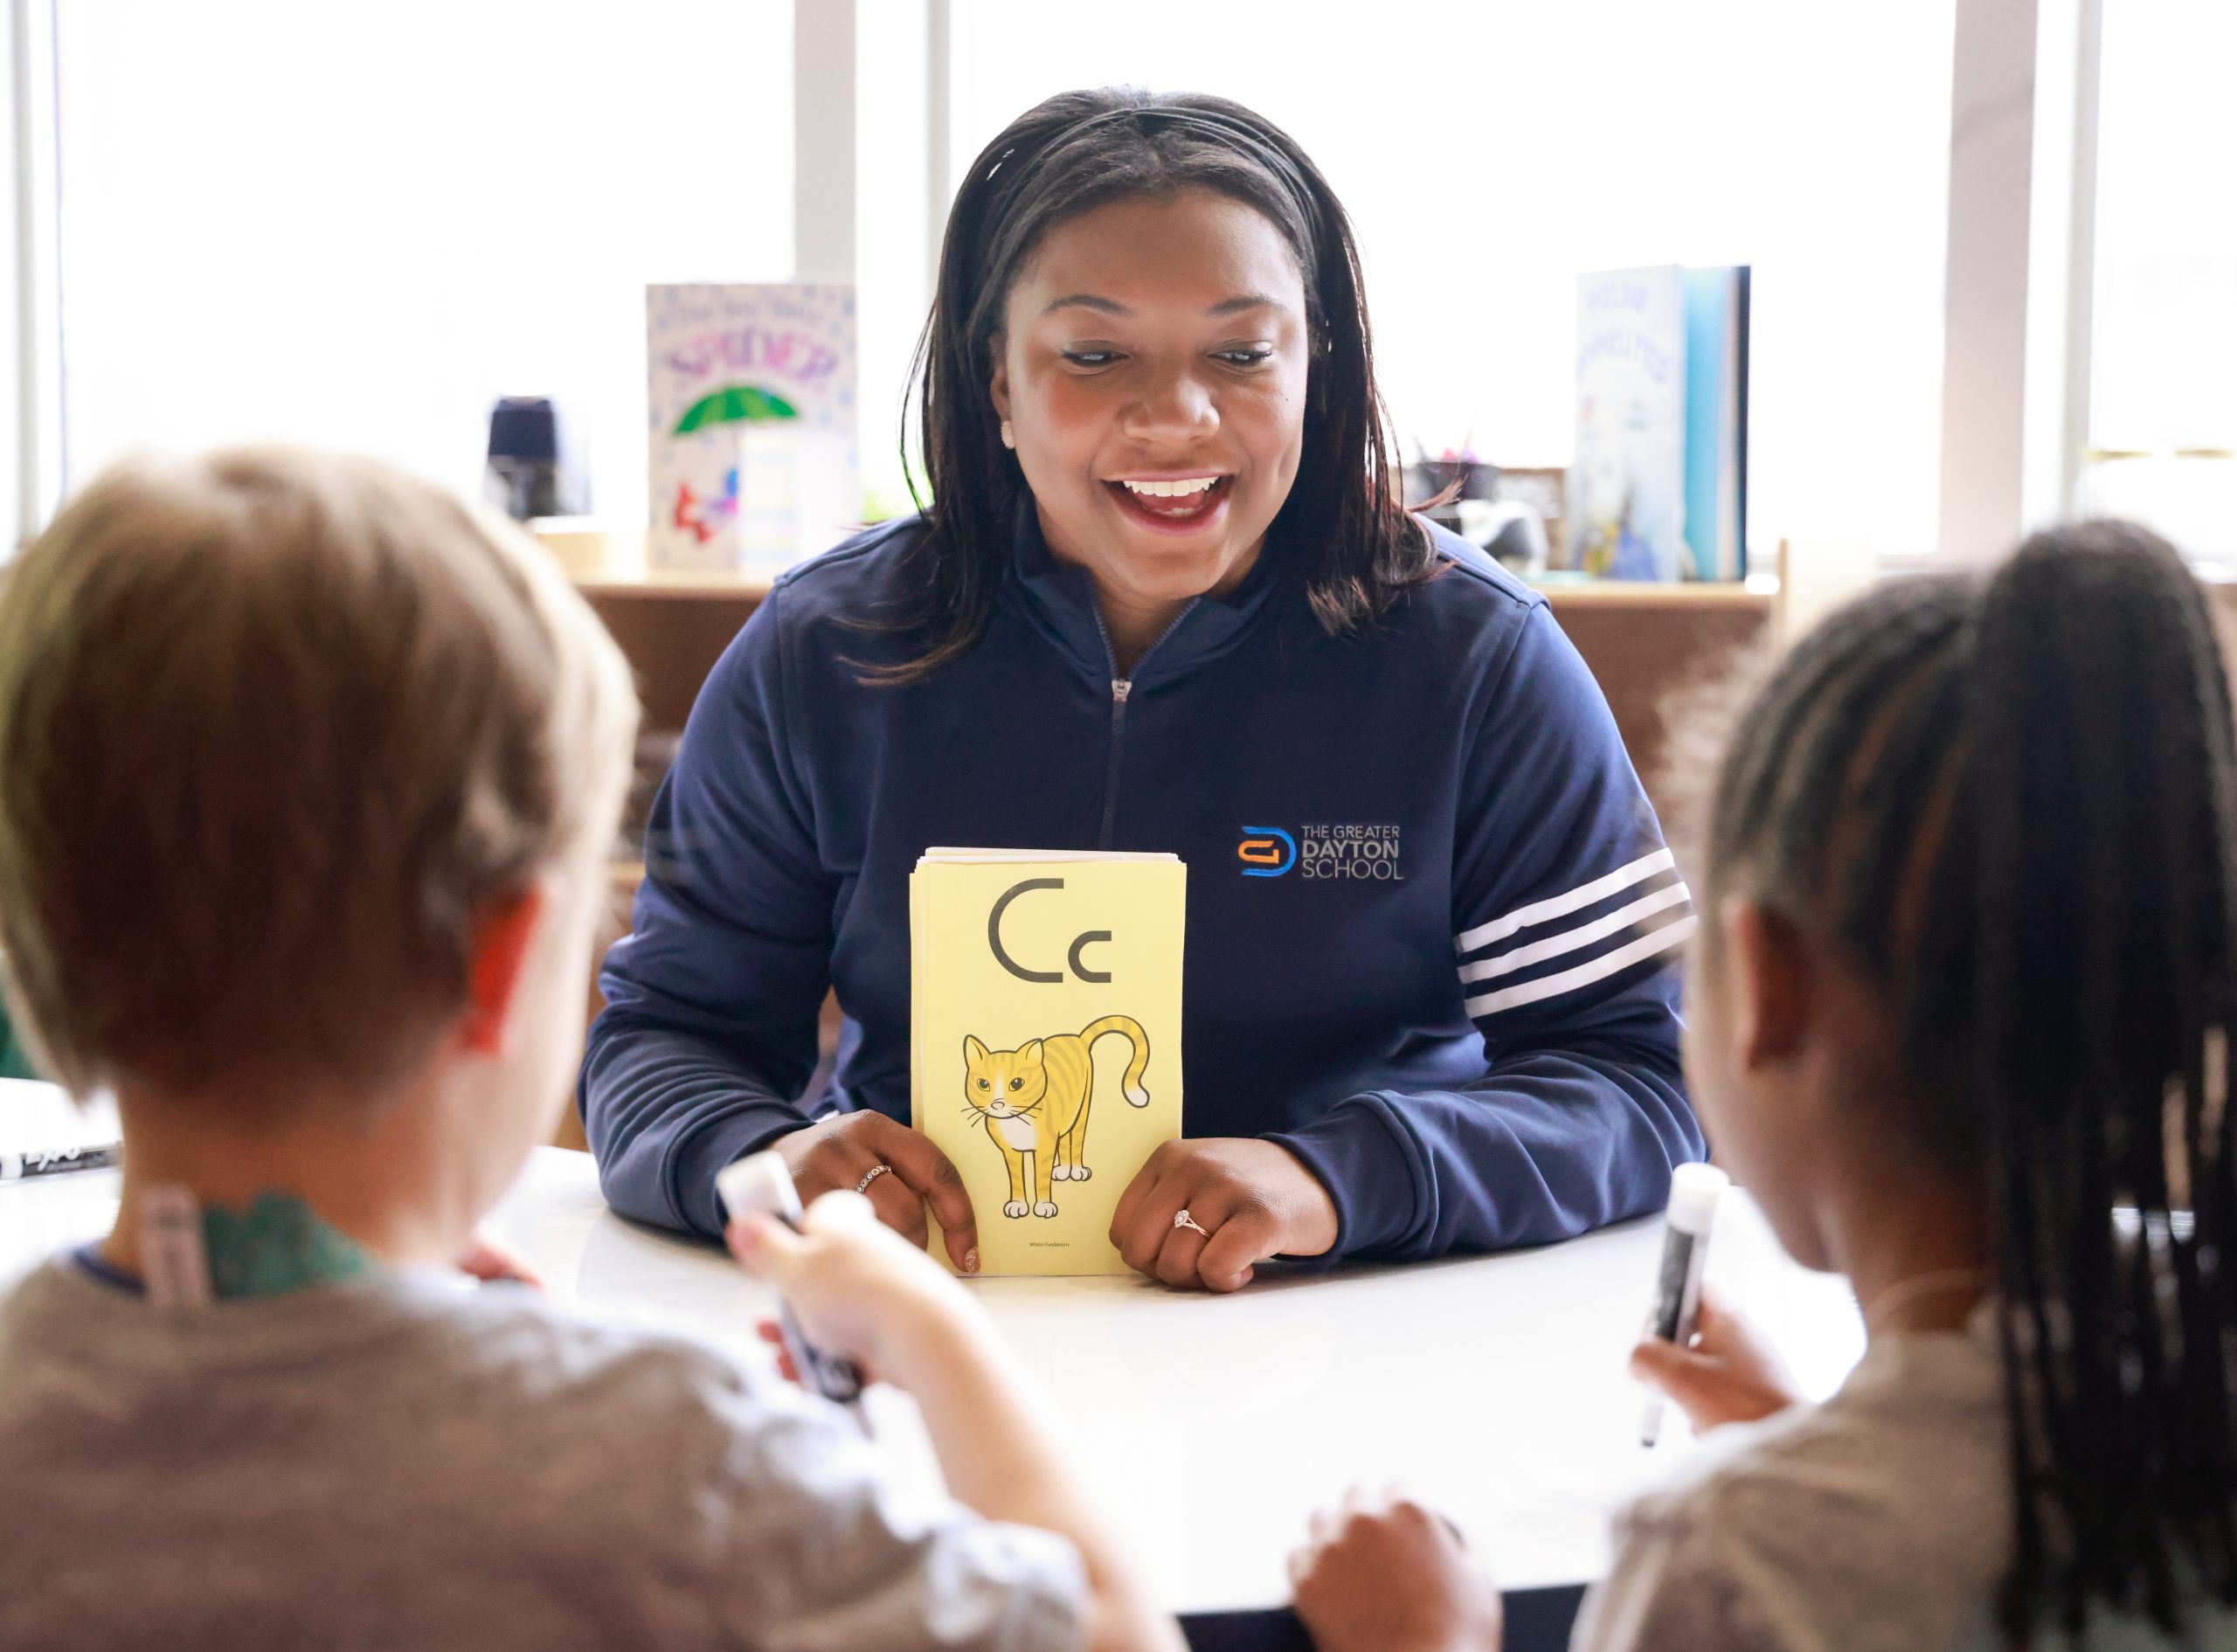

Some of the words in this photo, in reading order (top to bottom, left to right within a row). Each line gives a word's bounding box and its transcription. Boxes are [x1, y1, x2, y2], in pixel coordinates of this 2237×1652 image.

[1301, 826, 1329, 839] THE
[1333, 826, 1400, 840] GREATER
[1302, 840, 1399, 859] DAYTON
[1302, 859, 1404, 880] SCHOOL
